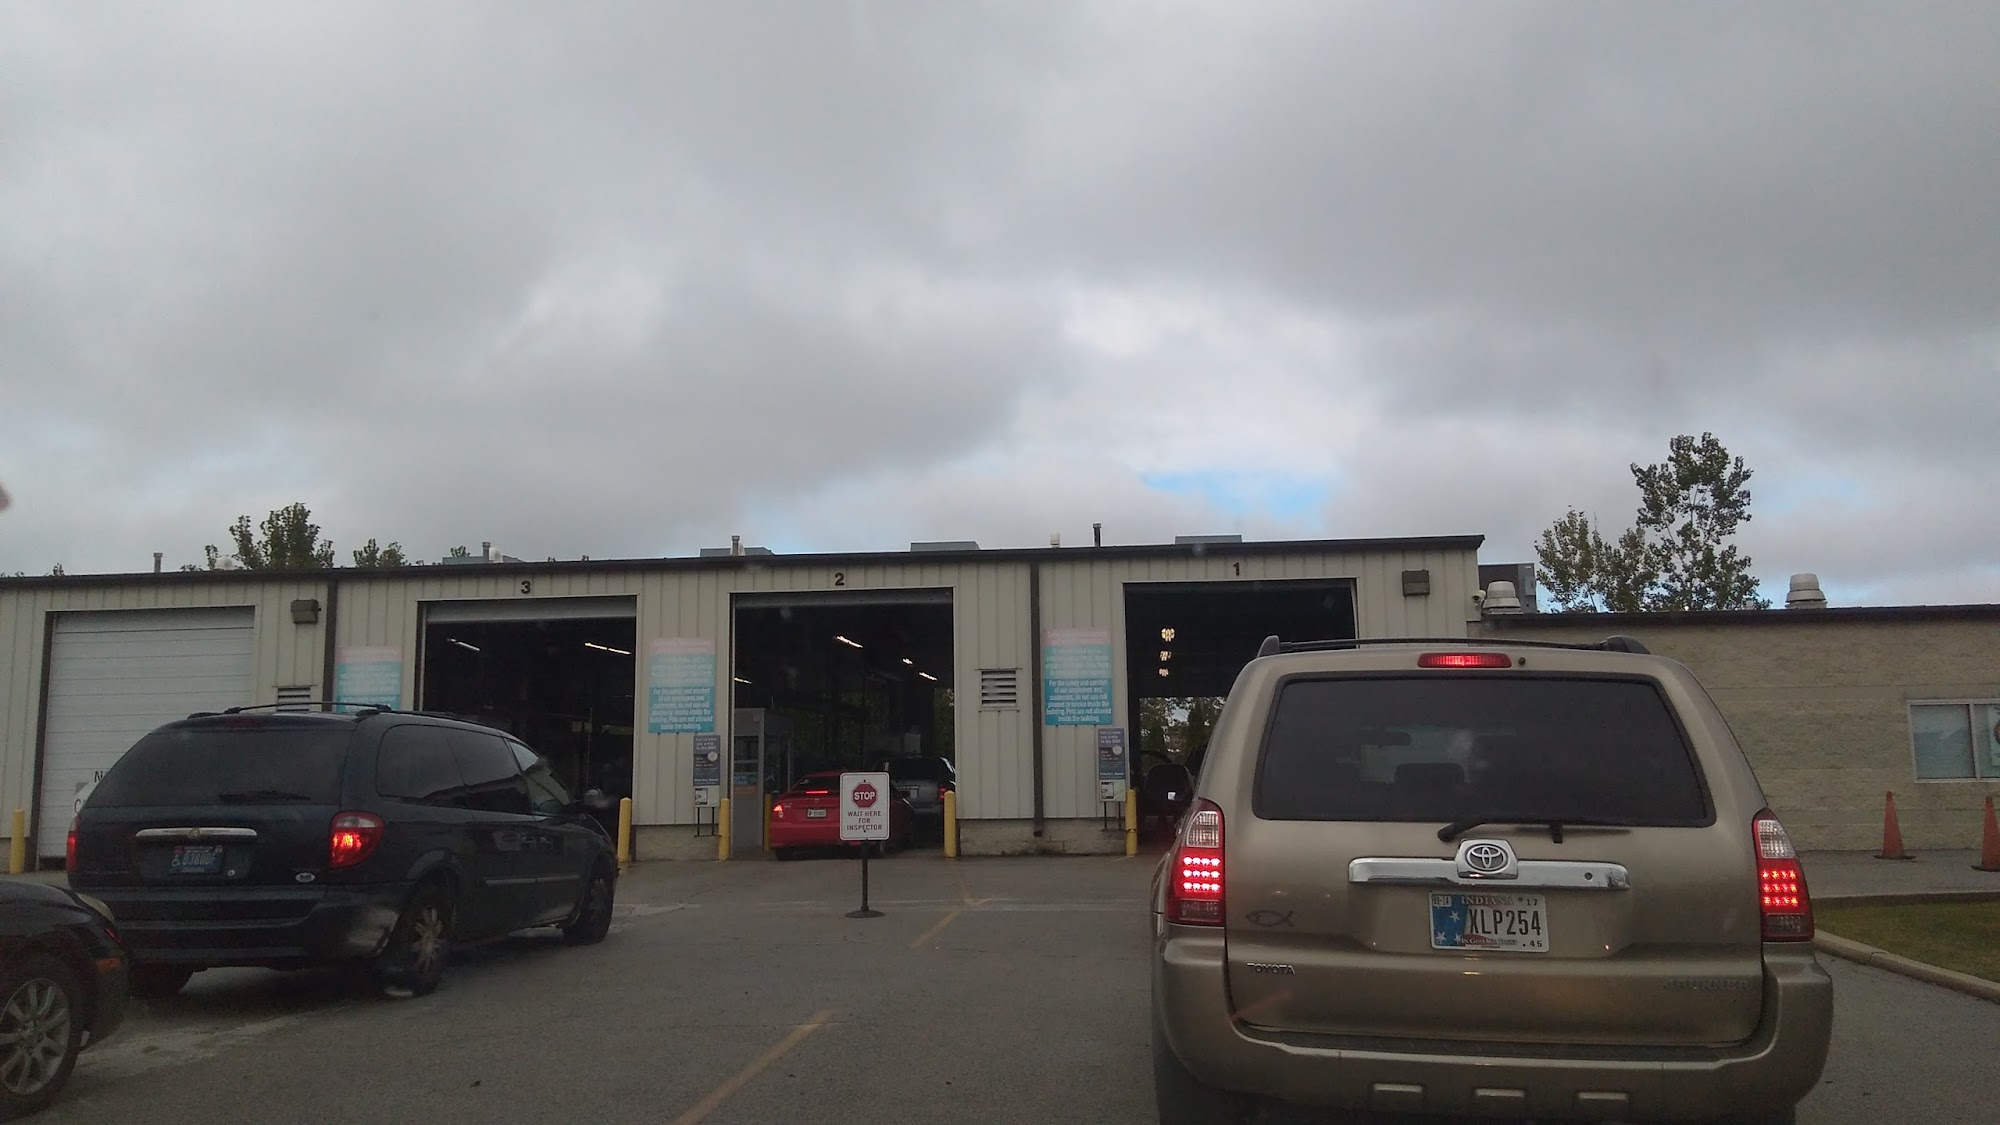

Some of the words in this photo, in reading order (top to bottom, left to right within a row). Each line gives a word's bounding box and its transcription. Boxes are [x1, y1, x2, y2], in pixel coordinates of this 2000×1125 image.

[1232, 562, 1240, 576] 1
[834, 572, 844, 586] 2
[521, 581, 531, 594] 3
[854, 792, 875, 800] STOP
[1461, 895, 1513, 905] INDIANA
[1469, 909, 1541, 936] XLP254
[1247, 963, 1295, 974] TOYOTA
